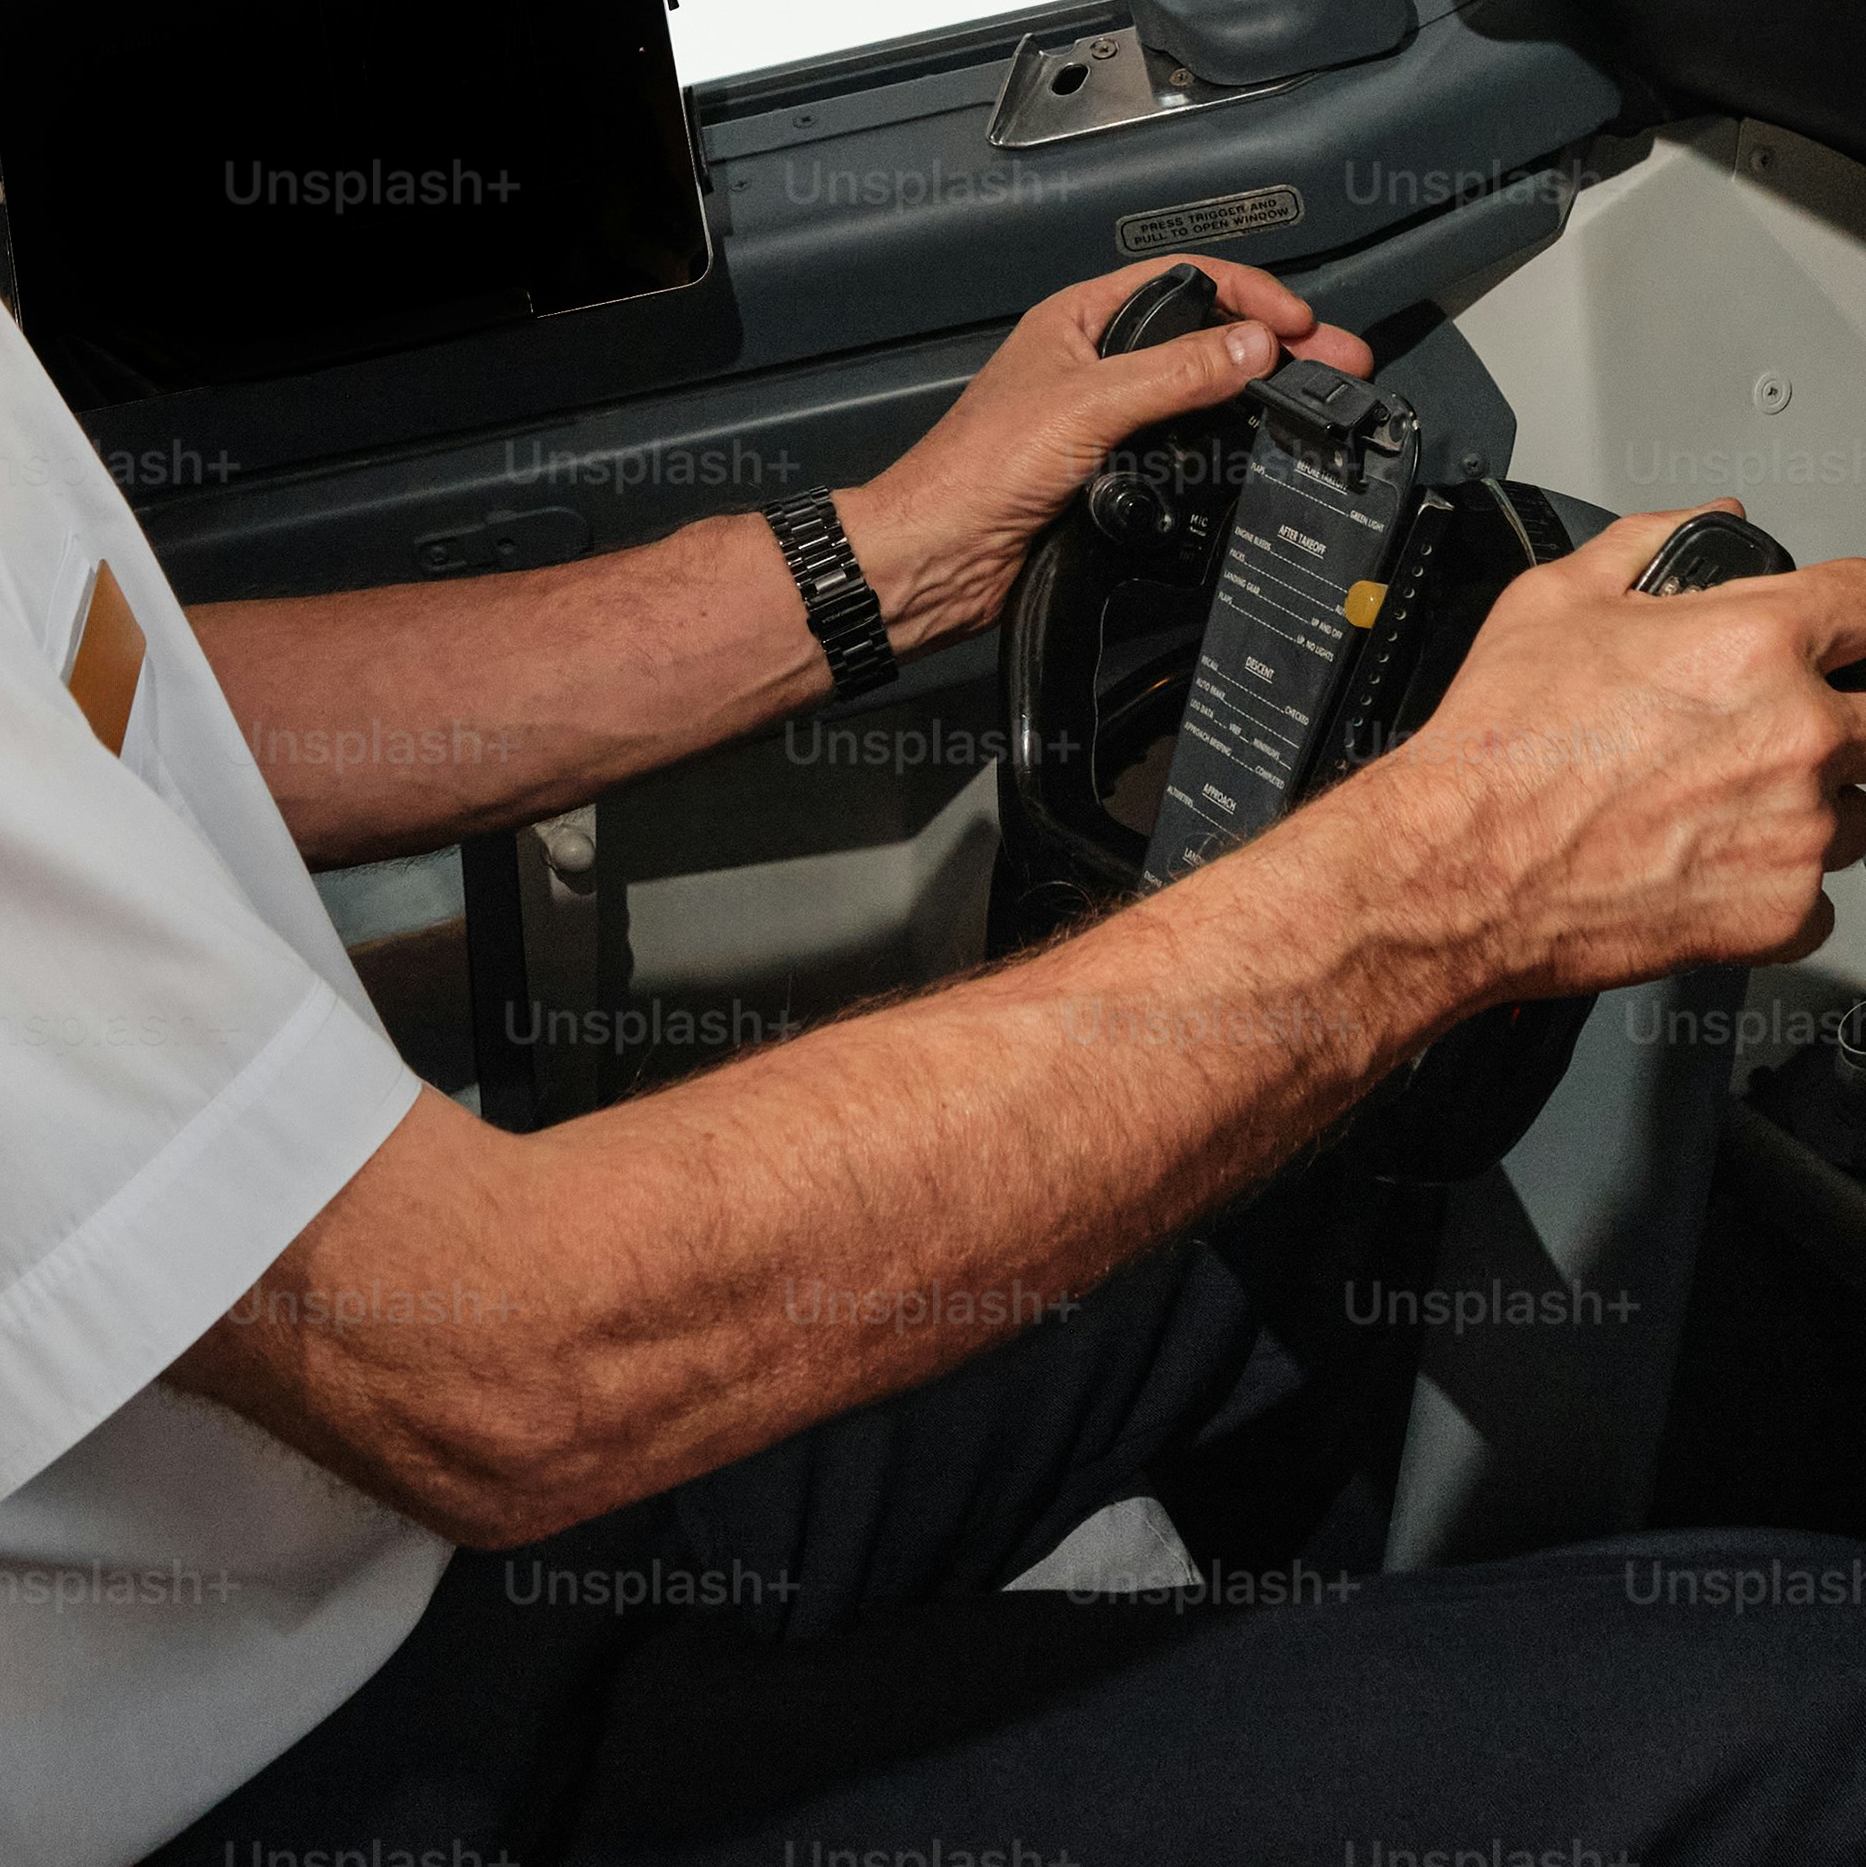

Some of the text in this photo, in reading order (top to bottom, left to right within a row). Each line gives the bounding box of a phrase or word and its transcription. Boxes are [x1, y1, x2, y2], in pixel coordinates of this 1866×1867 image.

[1134, 207, 1289, 246] PULL TO OPEN WINDOW
[1141, 199, 1277, 233] PRESS TRIGGER AND
[1190, 513, 1209, 528] MIC
[1349, 510, 1385, 534] GREEN LIGHT
[1234, 526, 1254, 545] ENGINE
[1278, 524, 1327, 555] AFTER TAKEOFF
[1229, 548, 1246, 563] PACKS
[1223, 570, 1261, 595] LANDING GEAR
[1306, 640, 1334, 662] NO LIGHTS
[1245, 655, 1275, 679] DESCENT
[1196, 677, 1226, 700] AUTO BRAKE
[1284, 704, 1309, 726] CHECKED
[1184, 721, 1211, 743] APPROACH
[1255, 765, 1285, 789] COMPLETED
[1203, 783, 1237, 811] APPROACH
